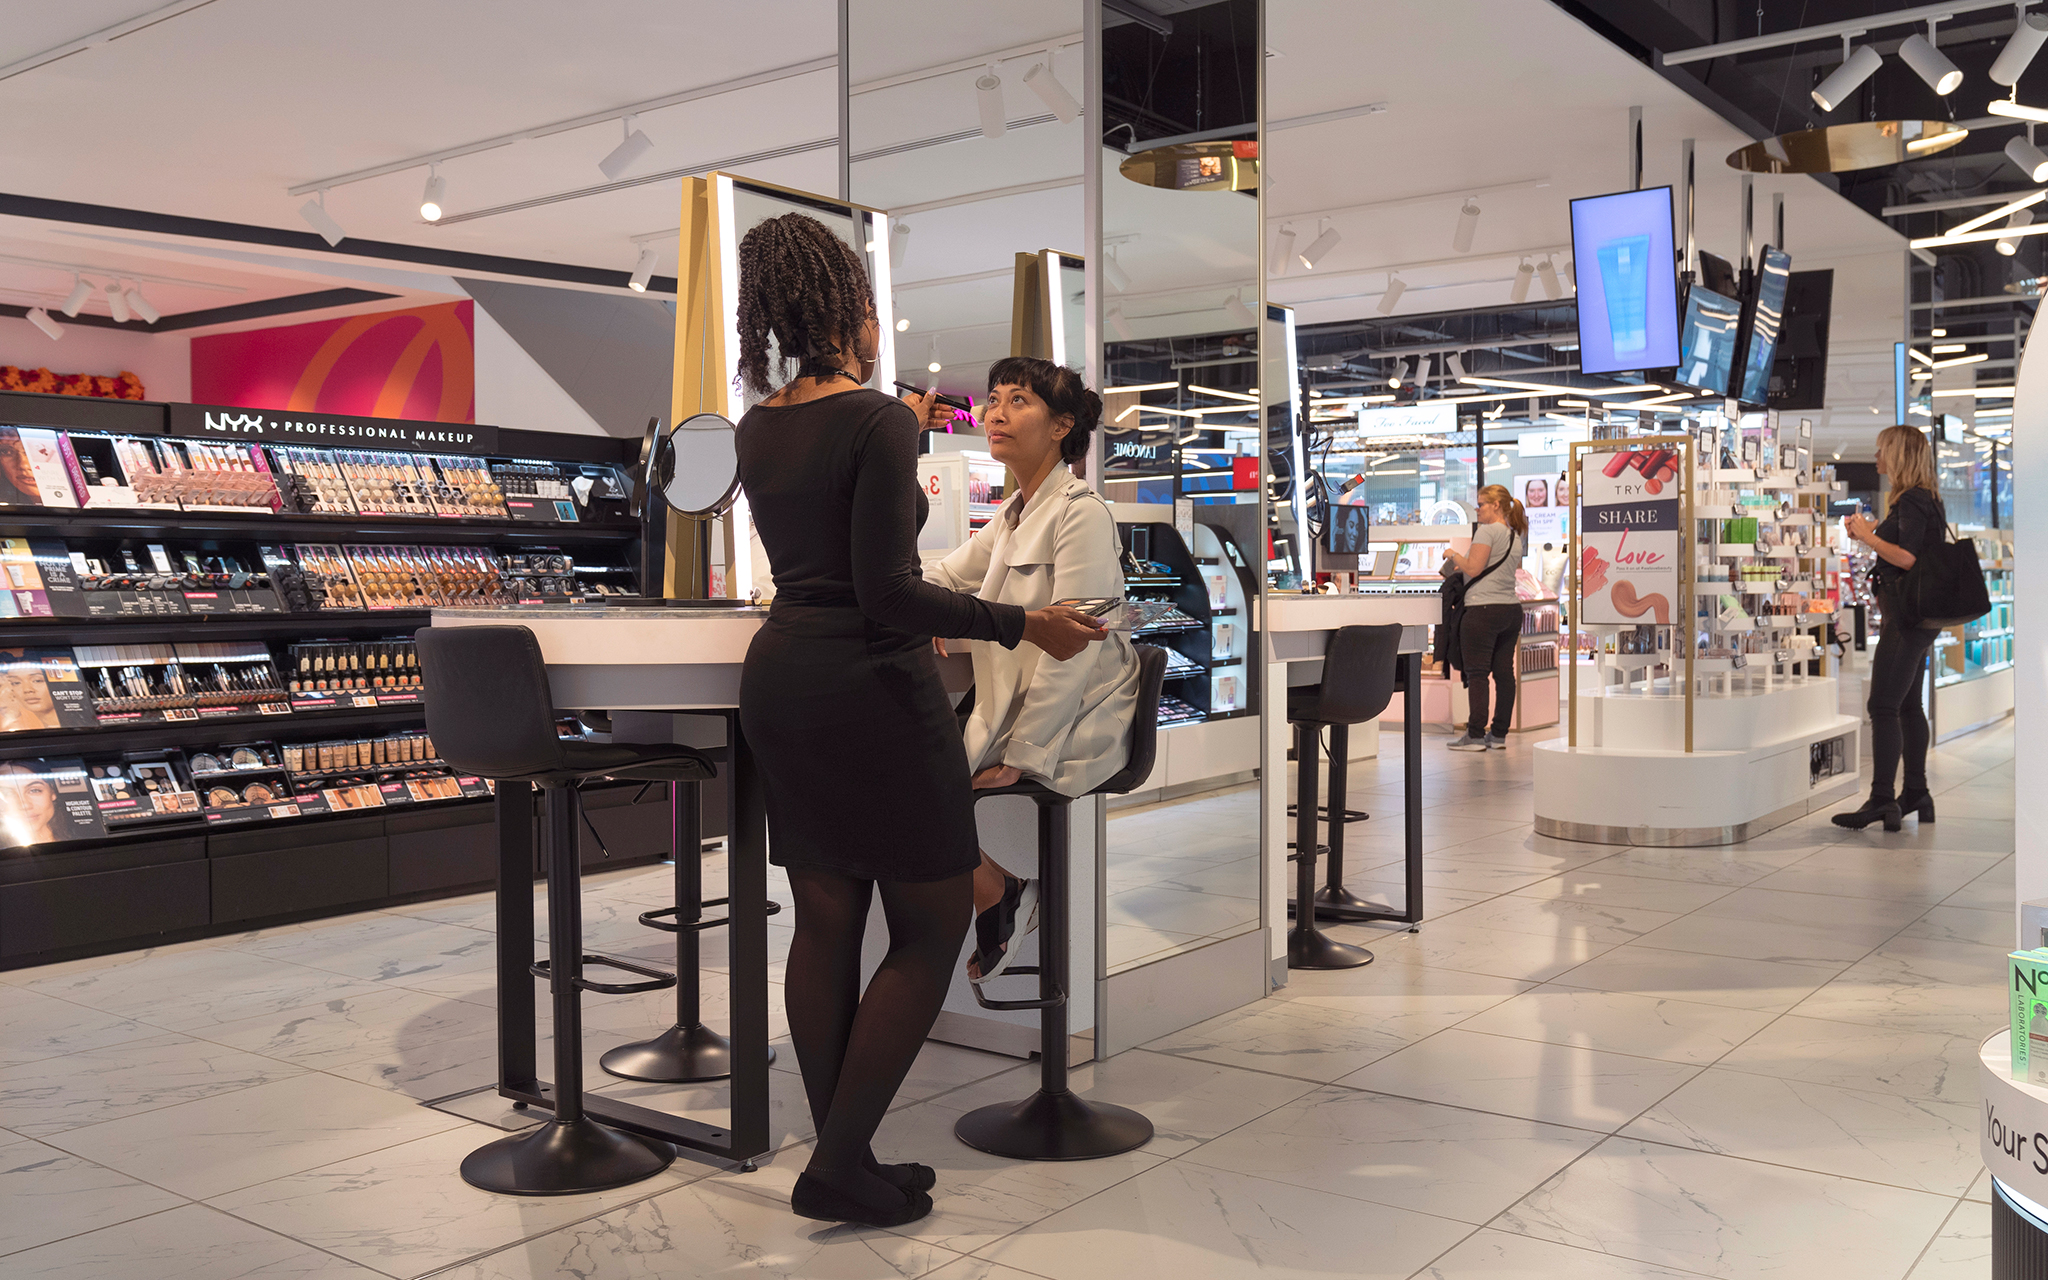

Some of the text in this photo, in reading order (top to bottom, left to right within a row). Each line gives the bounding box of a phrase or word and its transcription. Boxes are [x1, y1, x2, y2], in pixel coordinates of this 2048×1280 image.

[205, 411, 474, 444] NYX PROFESSIONAL MAKEUP
[1614, 484, 1642, 495] TRY
[1598, 509, 1658, 524] SHARE
[2017, 994, 2027, 1062] LABORATORIES
[1984, 1097, 2027, 1162] Your
